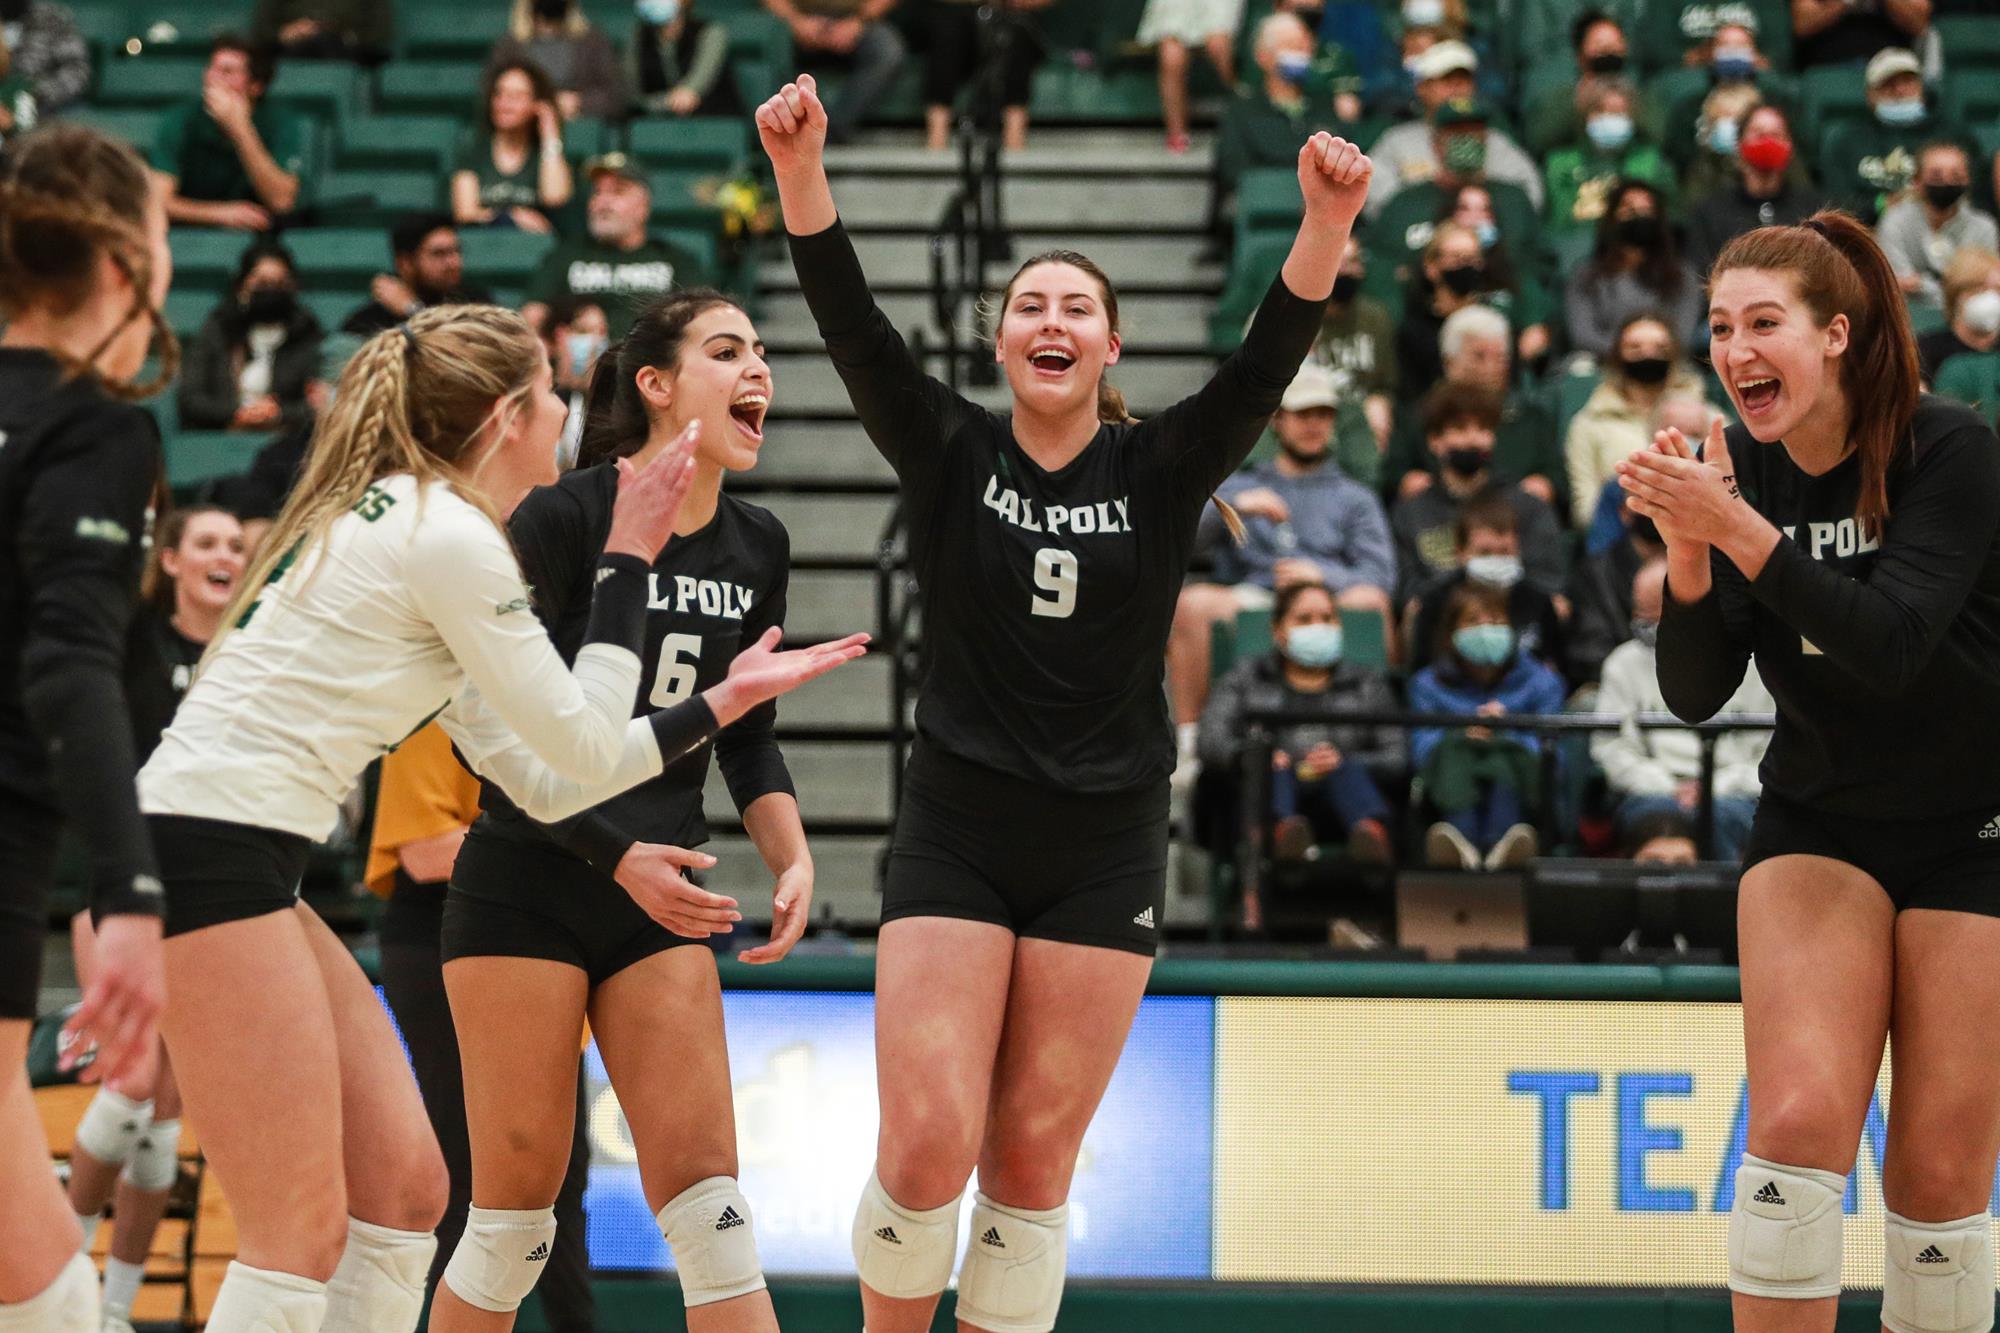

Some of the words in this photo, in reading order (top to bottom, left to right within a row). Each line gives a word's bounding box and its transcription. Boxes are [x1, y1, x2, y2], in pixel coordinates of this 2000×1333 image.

[1045, 496, 1132, 536] POLY
[1808, 518, 1879, 560] POL
[674, 575, 754, 620] POLY
[1031, 548, 1078, 618] 9
[649, 632, 703, 709] 6
[1753, 1194, 1786, 1206] adidas
[715, 1217, 745, 1231] adidas
